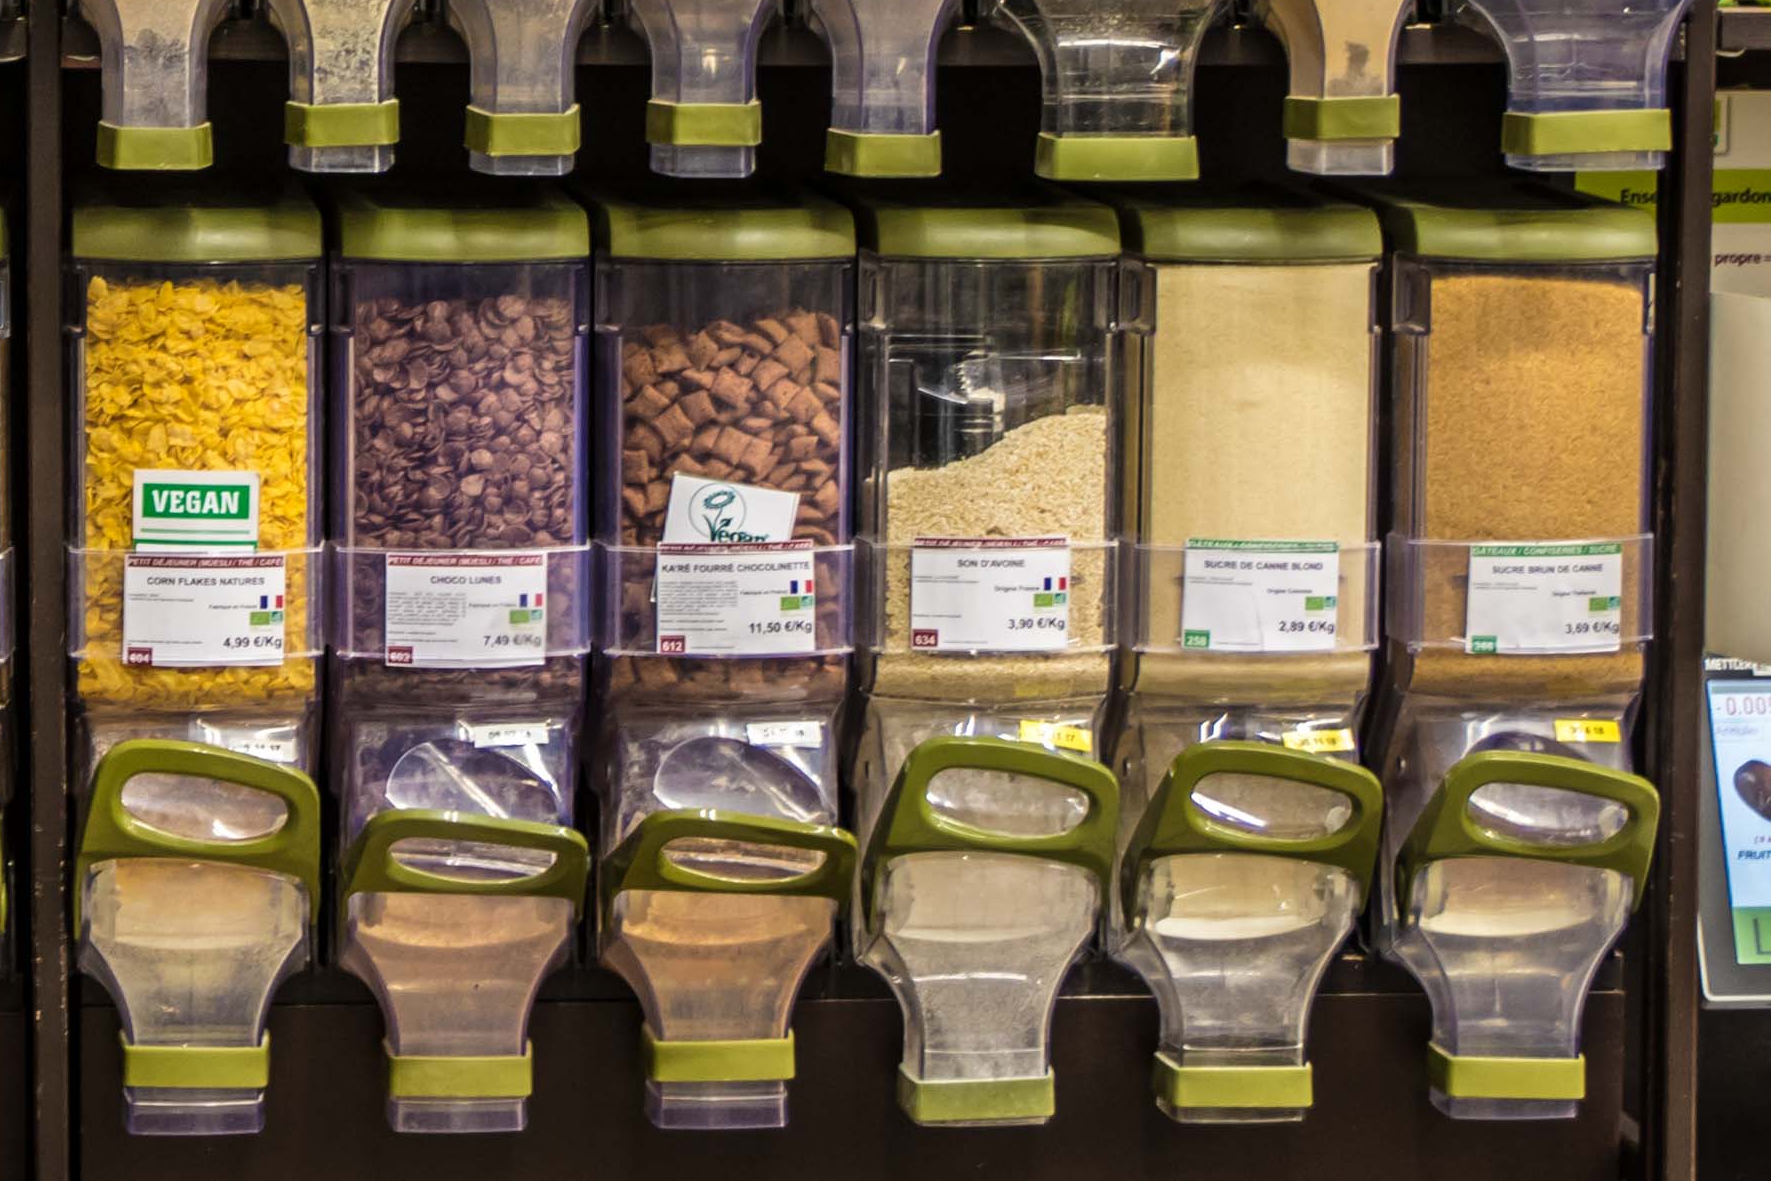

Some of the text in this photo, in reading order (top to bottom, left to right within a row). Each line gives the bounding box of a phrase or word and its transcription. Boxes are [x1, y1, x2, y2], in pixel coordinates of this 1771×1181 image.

[1714, 253, 1761, 267] propre
[151, 489, 240, 514] VEGAN
[736, 560, 810, 573] CHOCOLINETTE
[957, 558, 979, 568] SON
[1203, 559, 1324, 571] SUCRE DE CANNE BLOND
[1492, 563, 1603, 575] SUCRE BRUN DE CANNE
[146, 576, 265, 587] CORN FLAKES NATURES
[429, 575, 502, 585] CHOCO LUNES
[747, 620, 813, 635] 11,50 €/Kg
[1007, 618, 1065, 631] 3,90 €/Kg
[1278, 620, 1335, 634] 2,89 €/Kg
[222, 636, 282, 650] 4,99 €/Kg
[483, 634, 541, 648] 7,49 €/Kg
[662, 641, 682, 651] 612
[915, 635, 935, 645] 634
